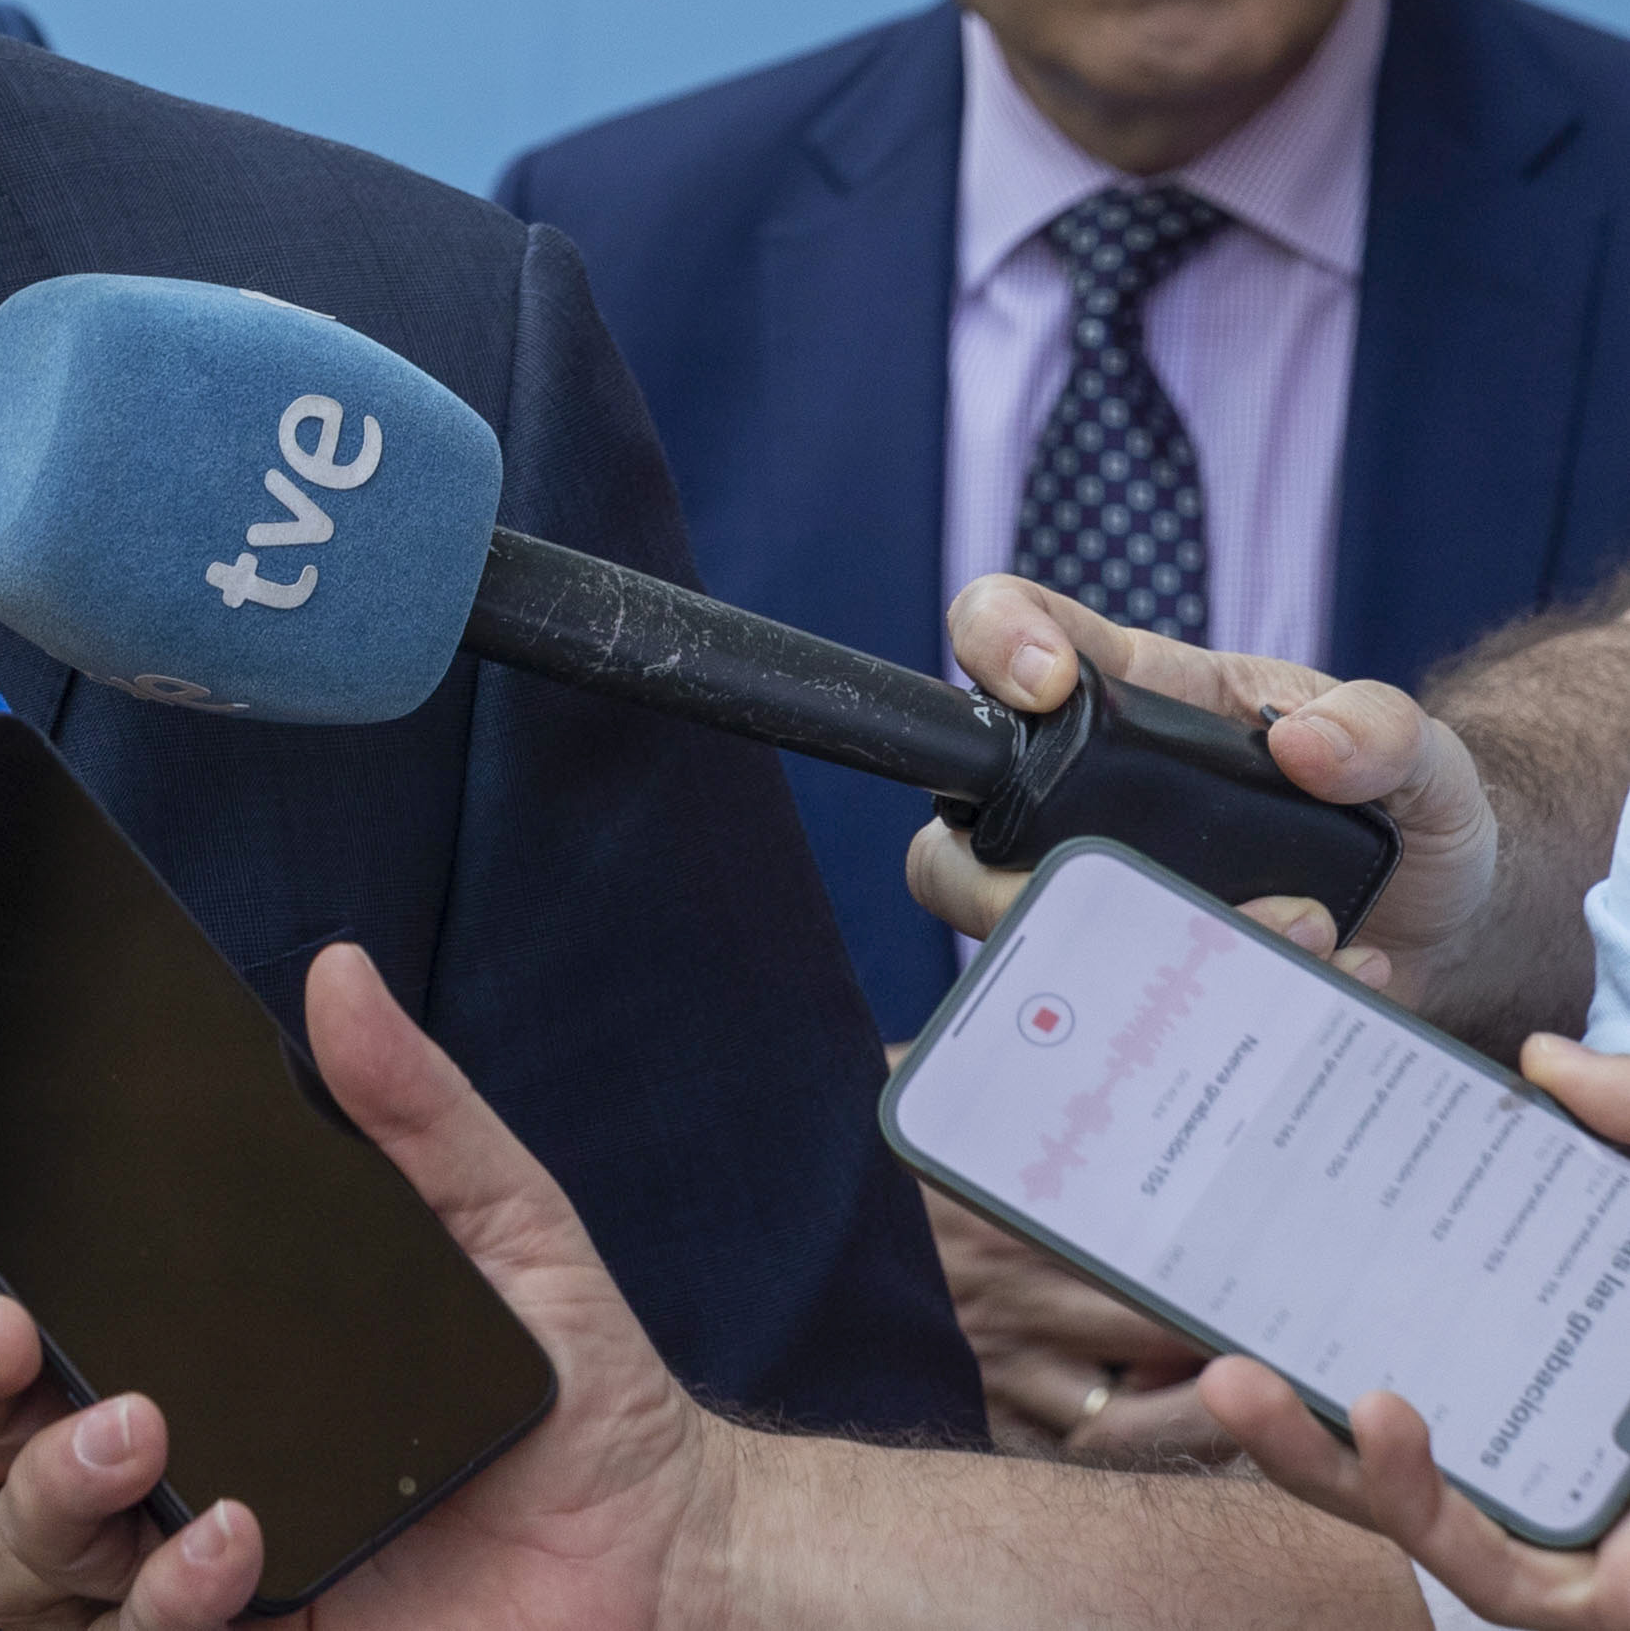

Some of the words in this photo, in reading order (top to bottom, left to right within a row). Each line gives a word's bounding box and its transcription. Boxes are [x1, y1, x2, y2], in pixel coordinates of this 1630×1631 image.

[205, 393, 383, 610] tve
[1212, 1031, 1261, 1090] Nueva
[1471, 1306, 1601, 1474] grabaciones
